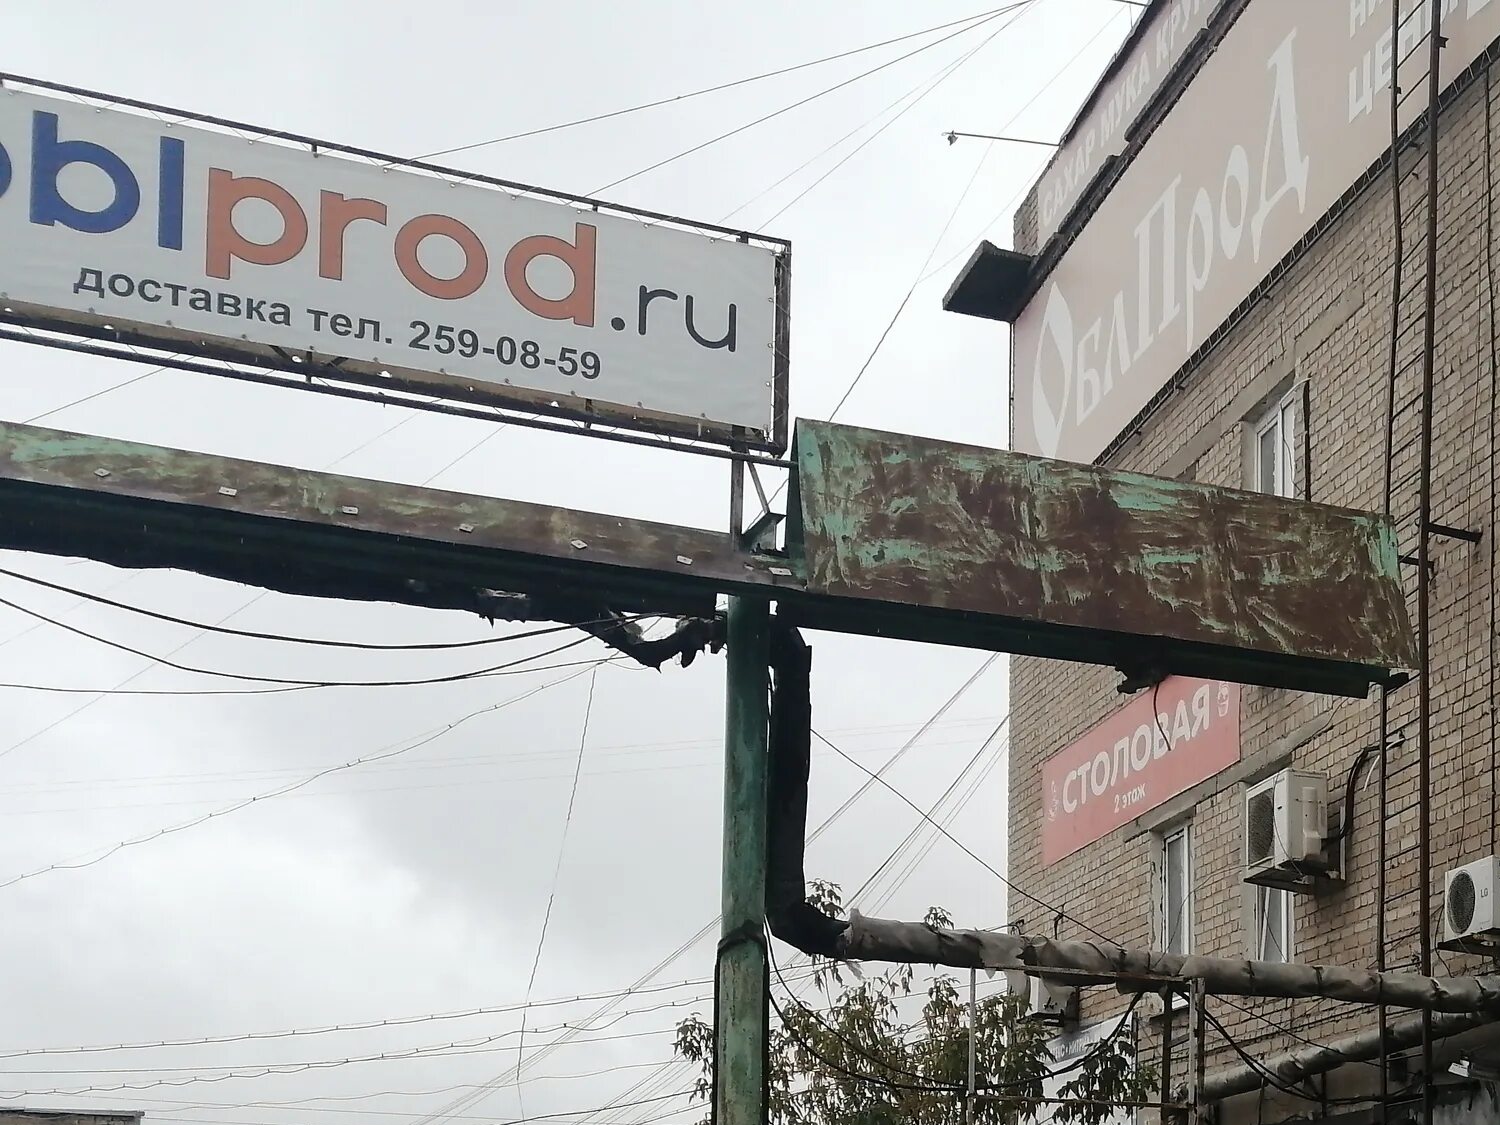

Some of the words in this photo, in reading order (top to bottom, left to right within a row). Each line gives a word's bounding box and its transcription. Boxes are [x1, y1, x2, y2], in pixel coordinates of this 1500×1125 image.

[0, 110, 738, 353] blprod.ru
[73, 266, 292, 327] доставка
[307, 306, 393, 345] тел.
[409, 319, 602, 381] 259-08-59
[1062, 684, 1210, 814] СТОЛОВАЯ
[1113, 794, 1120, 814] 2
[1122, 783, 1147, 809] этаж
[1480, 887, 1489, 898] LG
